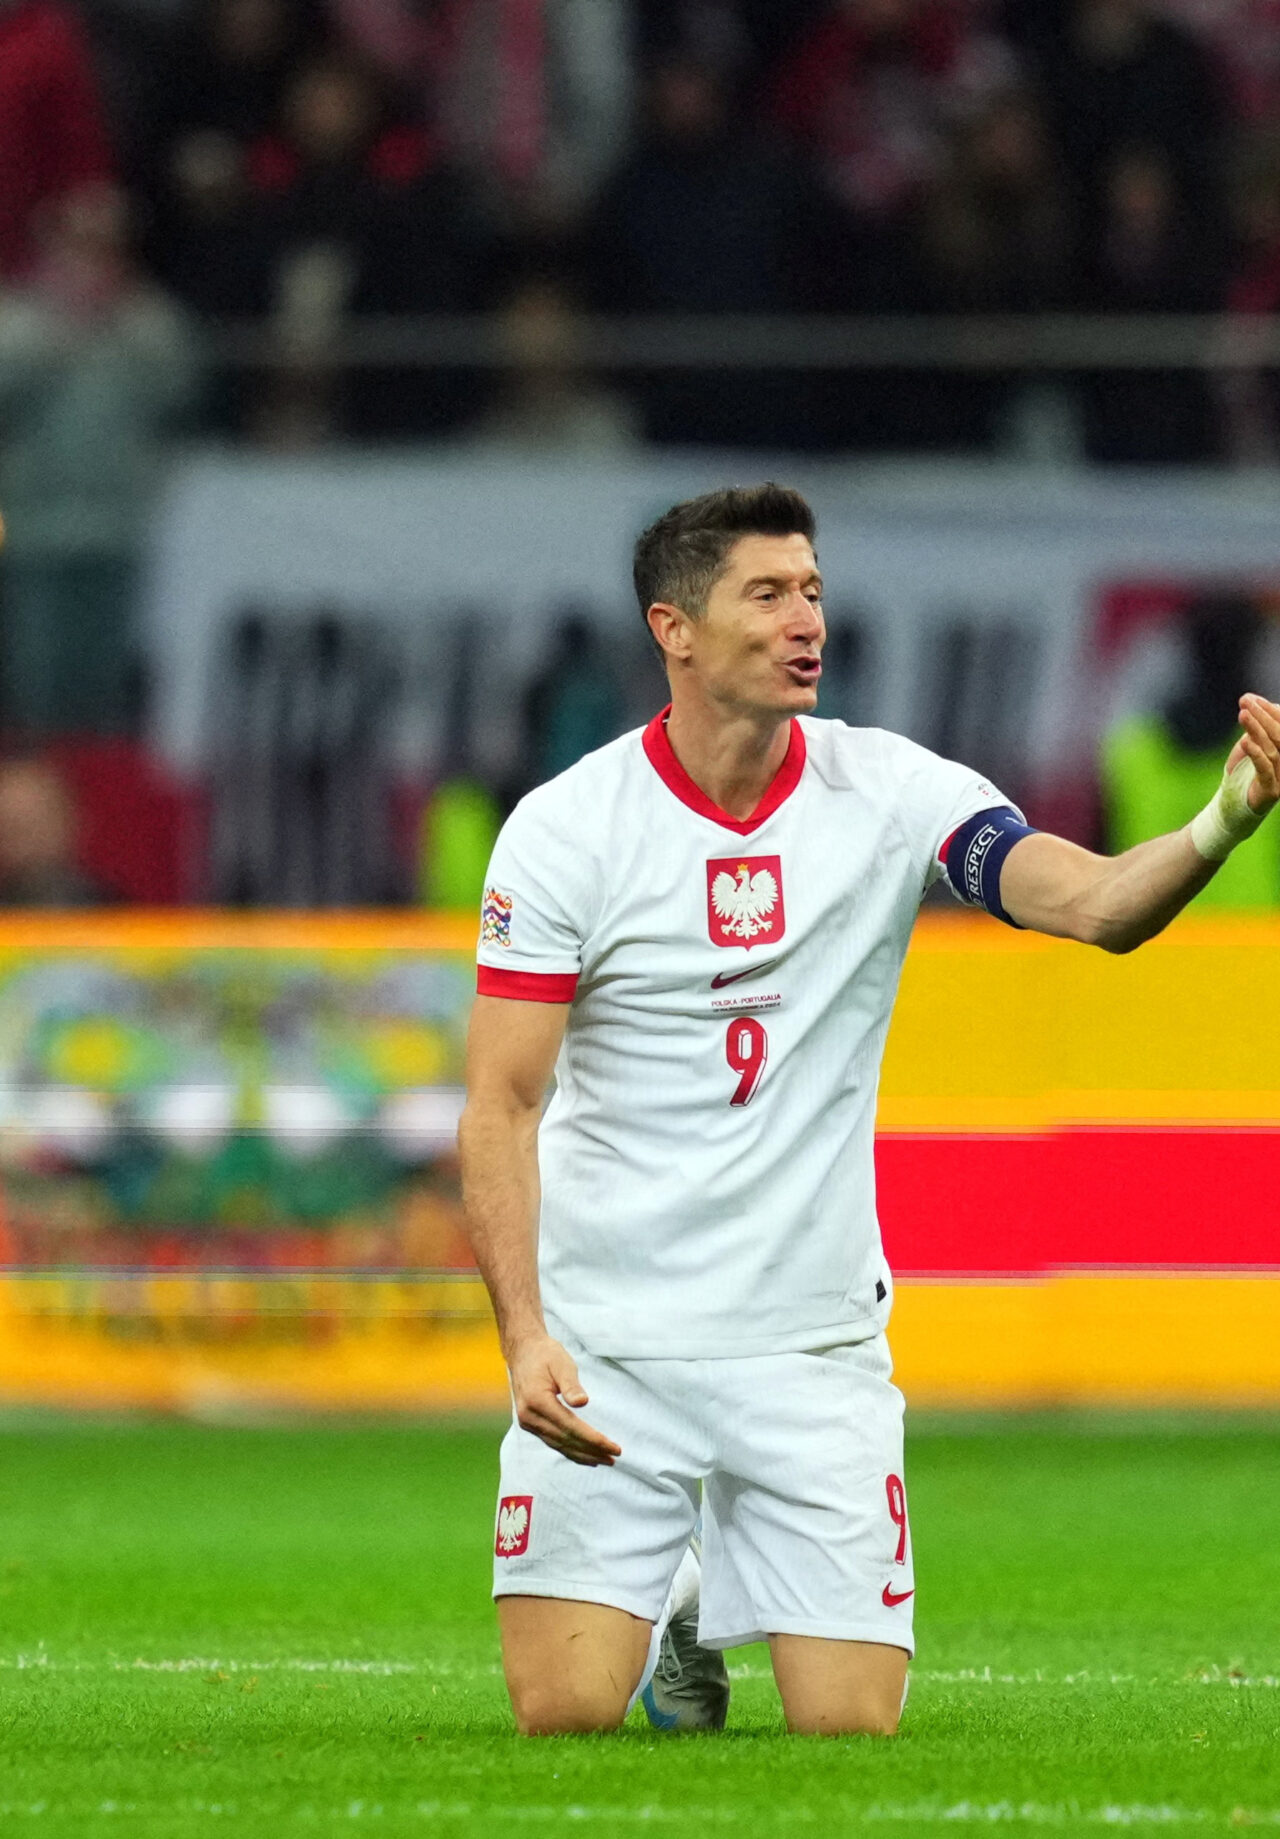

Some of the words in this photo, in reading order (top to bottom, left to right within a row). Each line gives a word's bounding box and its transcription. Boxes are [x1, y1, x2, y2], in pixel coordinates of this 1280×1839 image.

[968, 826, 998, 895] RESPECT
[711, 999, 737, 1007] POLSKA
[741, 993, 782, 1004] PORTUGALIA
[726, 1017, 768, 1107] 9
[886, 1474, 907, 1565] 9
